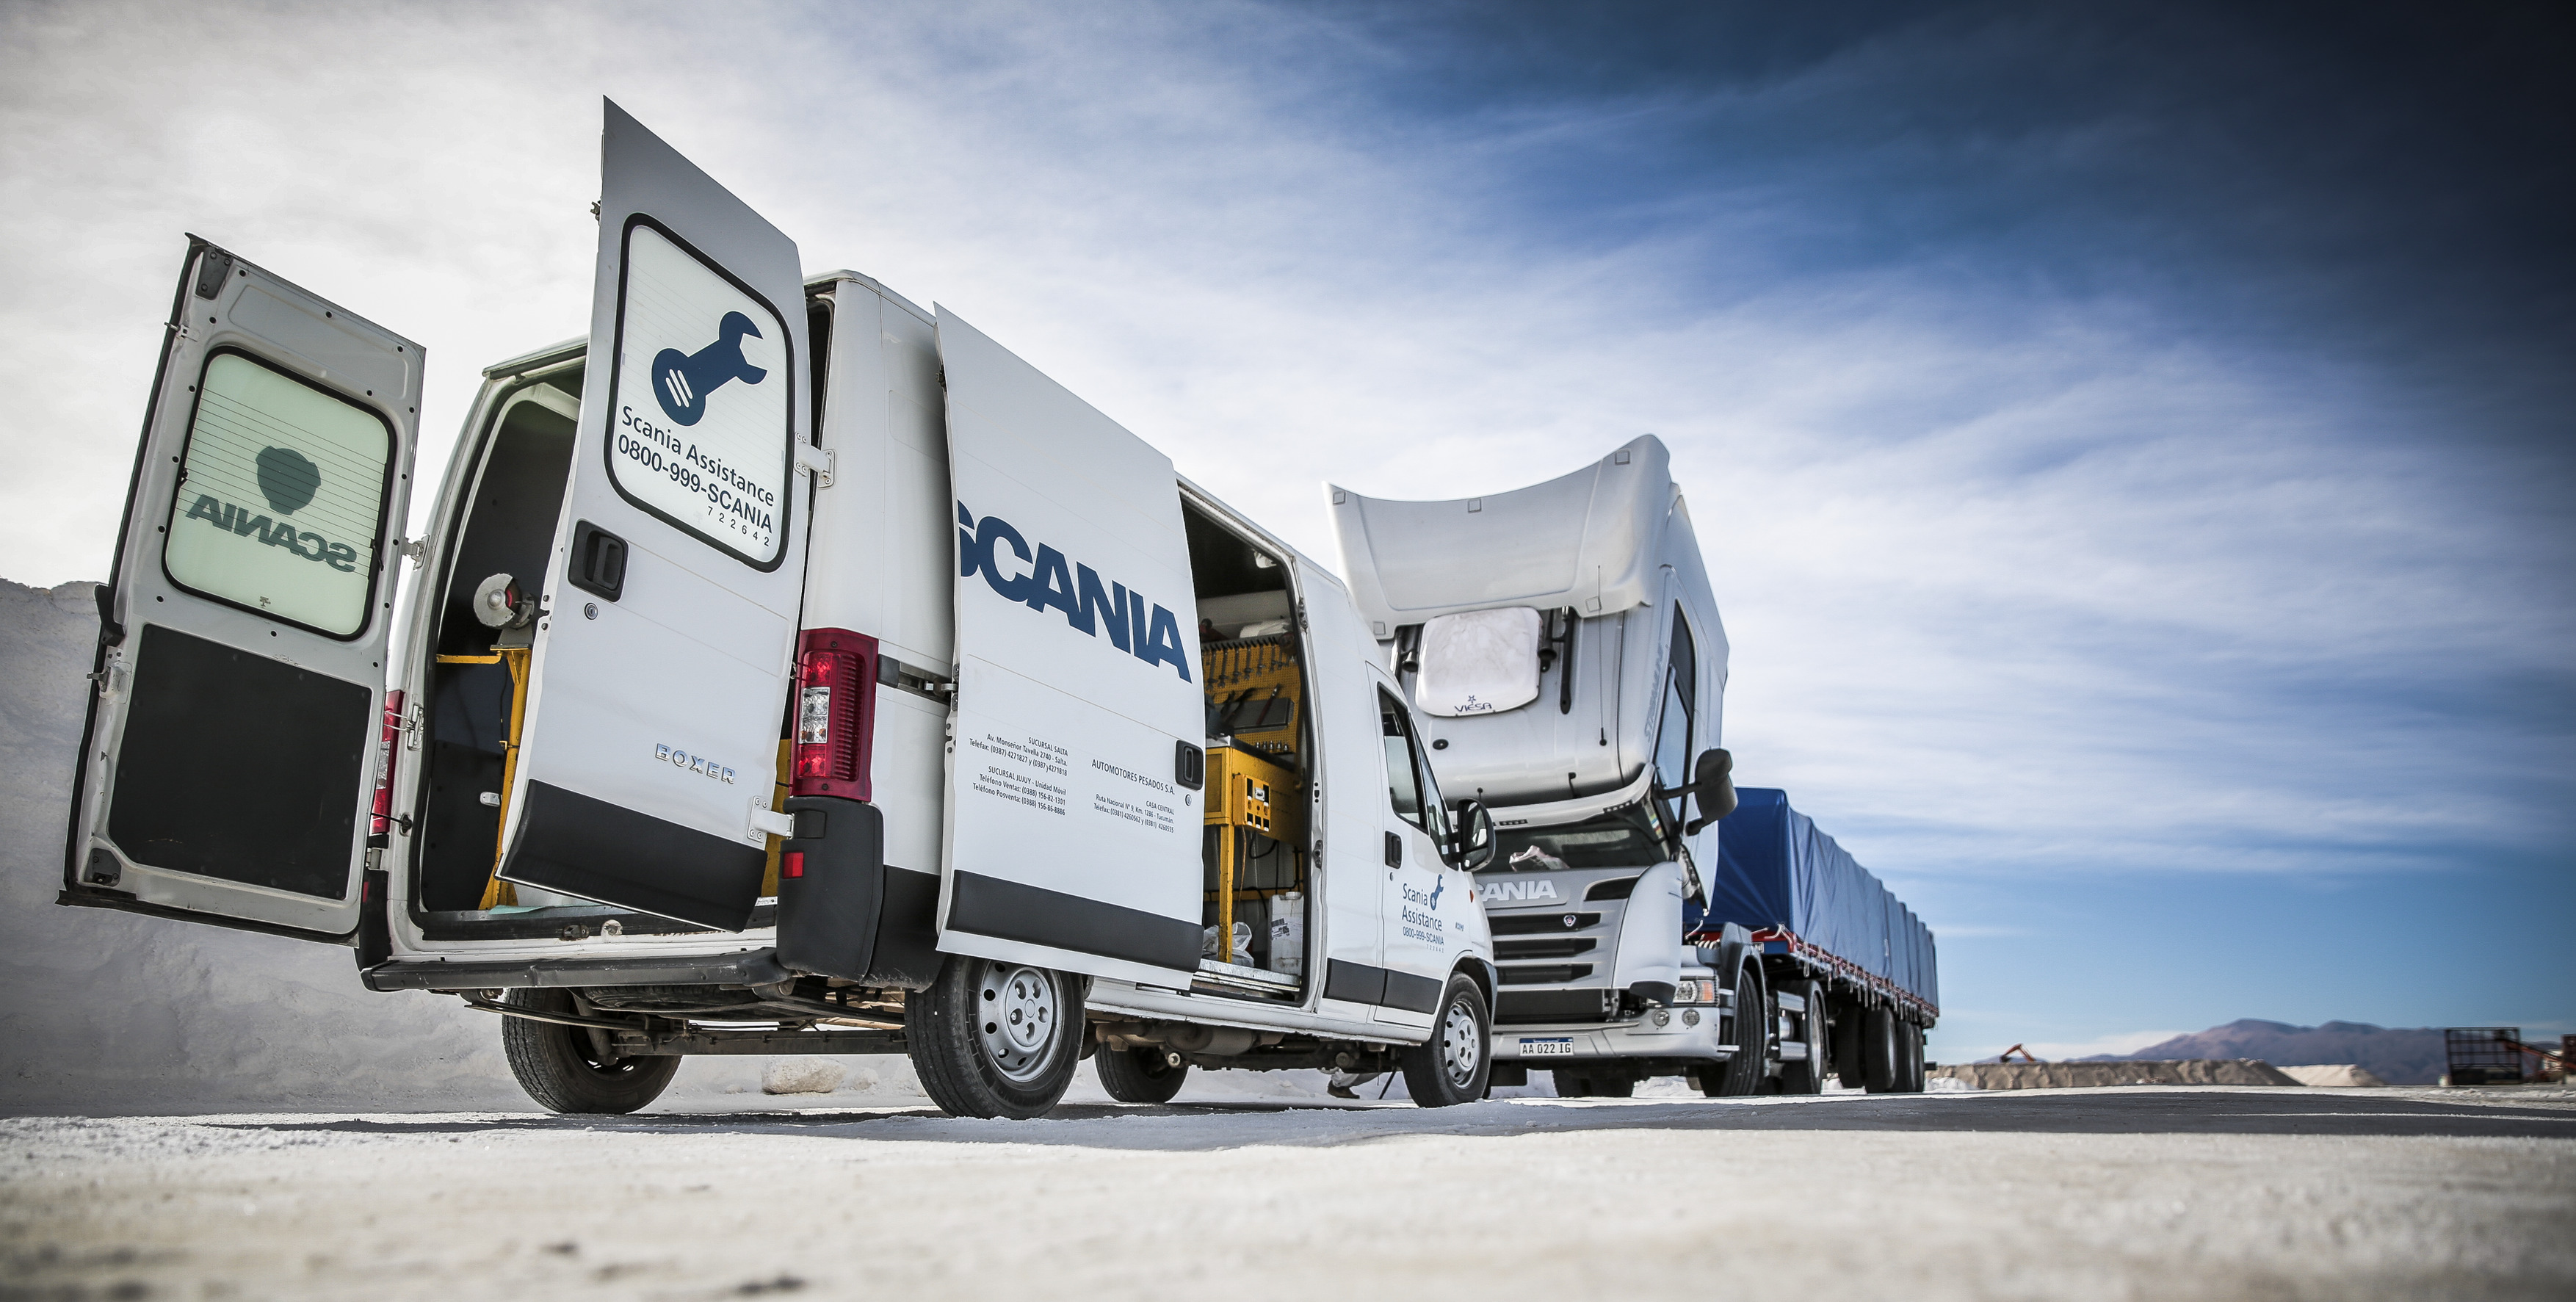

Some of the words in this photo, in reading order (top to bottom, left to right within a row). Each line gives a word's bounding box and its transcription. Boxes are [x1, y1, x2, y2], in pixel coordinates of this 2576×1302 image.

[623, 405, 681, 455] Scania
[686, 444, 774, 507] Assistance
[618, 434, 773, 534] 0800-999-SCANIA
[1454, 702, 1492, 712] VIESA
[969, 738, 989, 751] Telefax:
[991, 745, 1007, 757] (0387)
[1007, 751, 1027, 763] 4271827
[987, 734, 995, 742] Av.
[996, 737, 1021, 751] Monseñor
[1023, 745, 1039, 756] Tavella
[1040, 751, 1051, 761] 2740
[1028, 737, 1053, 751] SUCURSAL
[1054, 745, 1068, 756] SALTA
[655, 743, 735, 784] BOXER
[980, 773, 1002, 786] Teléfono
[1002, 781, 1021, 792] Ventas:
[1021, 786, 1037, 798] (0388)
[988, 765, 1015, 780] SUCURSAL
[1016, 774, 1031, 784] JUJUY
[1035, 780, 1052, 791] Unidad
[1091, 759, 1137, 782] AUTOMOTORES
[1138, 775, 1164, 791] PESADOS
[1165, 784, 1175, 795] S.A.
[972, 782, 995, 795] Teléfono
[996, 789, 1021, 803] Posventa:
[1096, 794, 1106, 802] Ruta
[1107, 798, 1124, 809] Nacional
[1094, 803, 1110, 814] Telefax:
[1110, 808, 1124, 818] (0381)
[1146, 800, 1157, 809] CASA
[1157, 804, 1174, 815] CENTRAL
[1403, 883, 1428, 906] Scania
[1476, 880, 1557, 902] ANIA
[1402, 905, 1442, 931] Assistance
[1403, 926, 1444, 945] 0800-999-SCANIA
[1522, 1044, 1534, 1054] AA
[1537, 1044, 1555, 1054] 022
